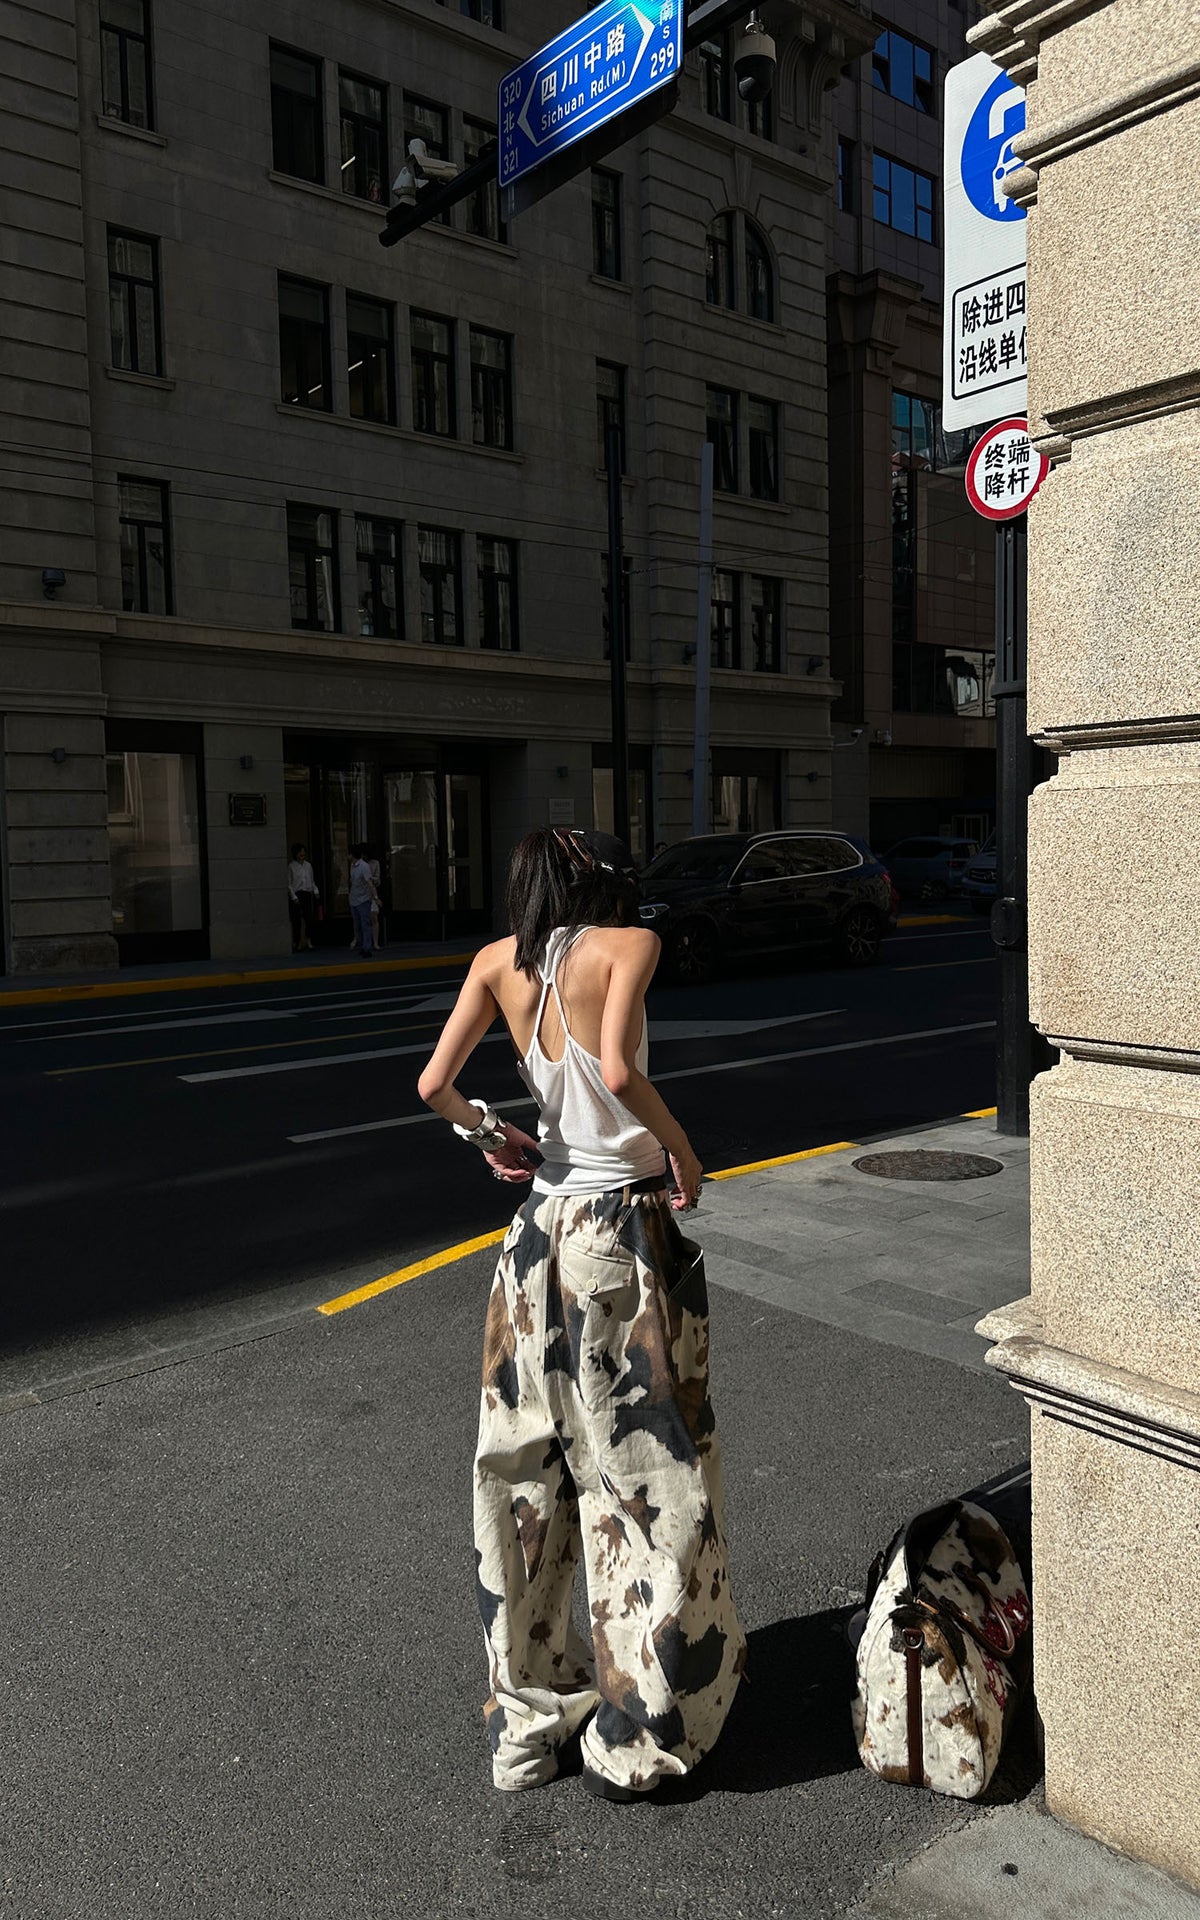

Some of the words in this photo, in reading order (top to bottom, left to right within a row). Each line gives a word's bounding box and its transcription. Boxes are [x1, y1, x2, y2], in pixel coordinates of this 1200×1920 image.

[660, 0, 674, 26] 南
[663, 25, 670, 39] S
[541, 23, 626, 106] 四川中路
[650, 42, 675, 79] 299
[503, 77, 522, 108] 320
[541, 93, 585, 131] Sichuan
[590, 60, 626, 99] Rd.(M)
[503, 111, 515, 134] 北
[506, 135, 513, 148] N
[503, 148, 519, 176] 321
[962, 280, 1026, 337] 除进四
[984, 436, 1031, 471] 终端
[984, 466, 1031, 500] 降杆
